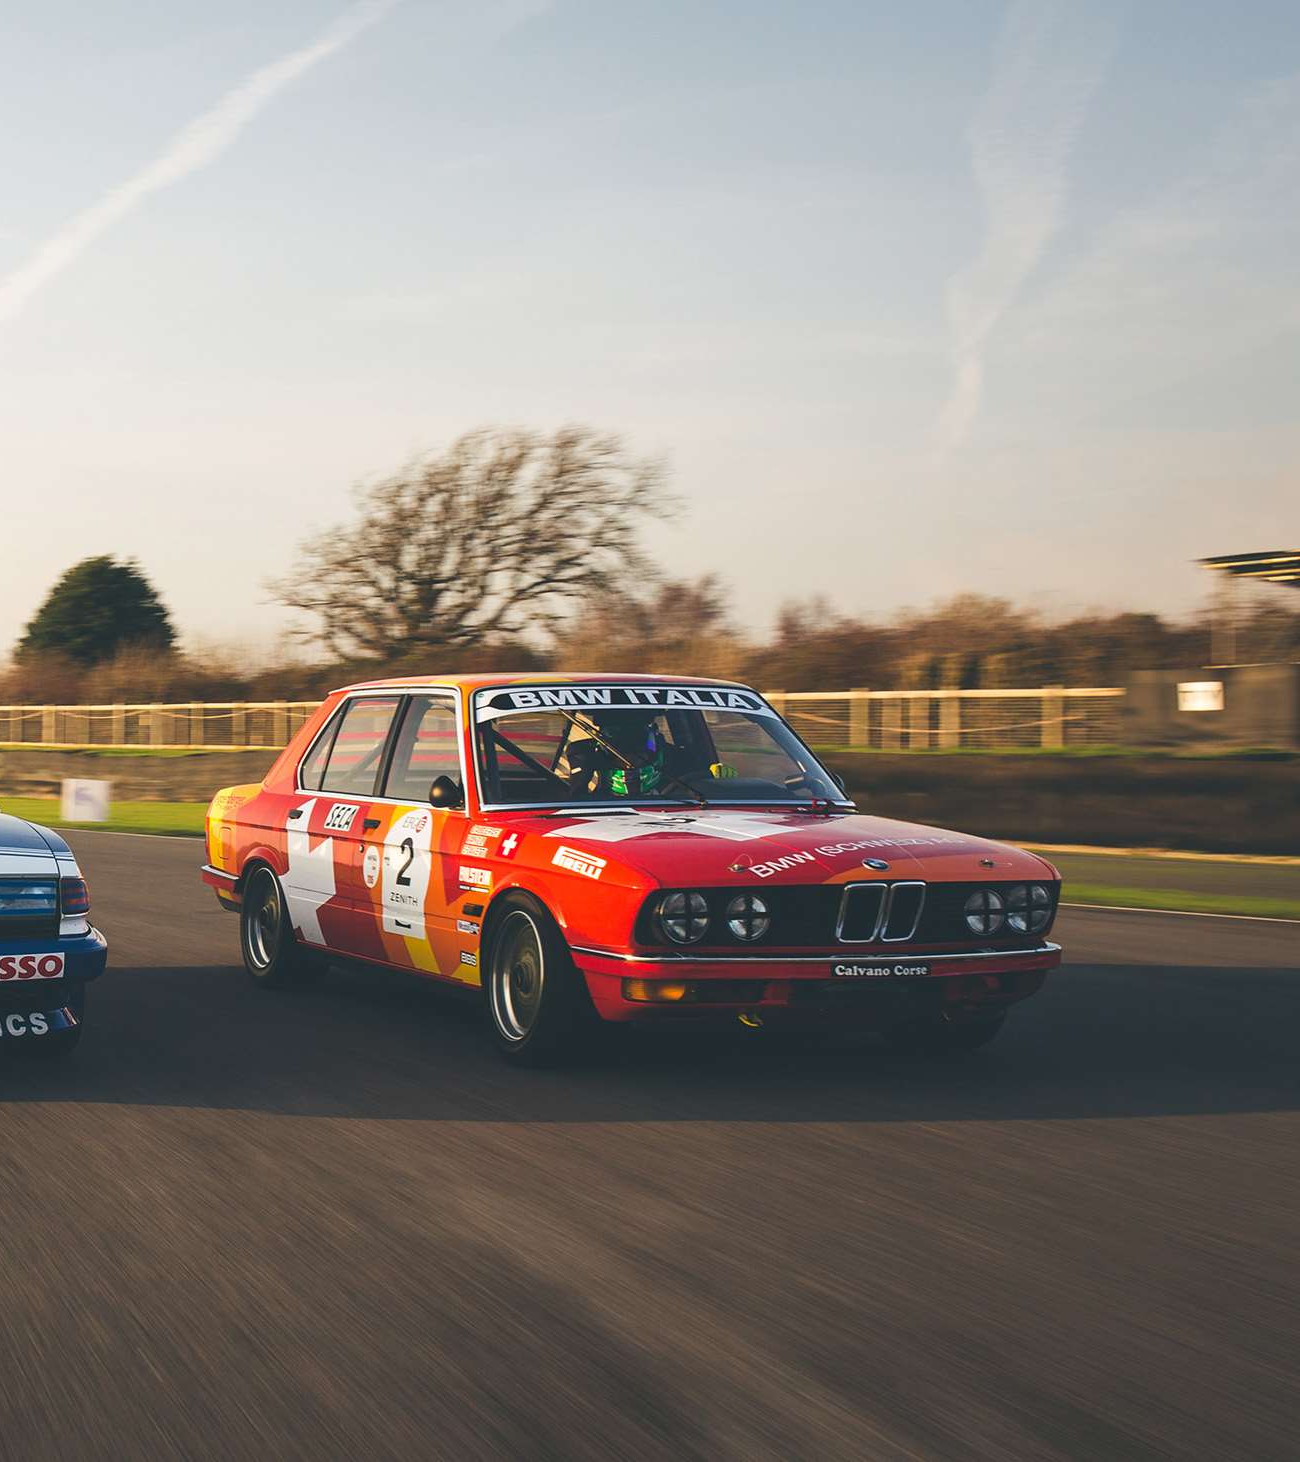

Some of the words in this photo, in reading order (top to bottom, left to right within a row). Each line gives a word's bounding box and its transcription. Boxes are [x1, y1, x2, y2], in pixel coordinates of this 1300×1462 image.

[509, 690, 613, 708] BMW
[625, 689, 752, 708] ITALIA
[396, 837, 414, 886] 2
[551, 846, 607, 880] PIRELLI
[748, 850, 816, 878] BMW
[390, 892, 419, 906] ZENITH
[834, 964, 891, 977] Calvano
[894, 965, 928, 976] Corse
